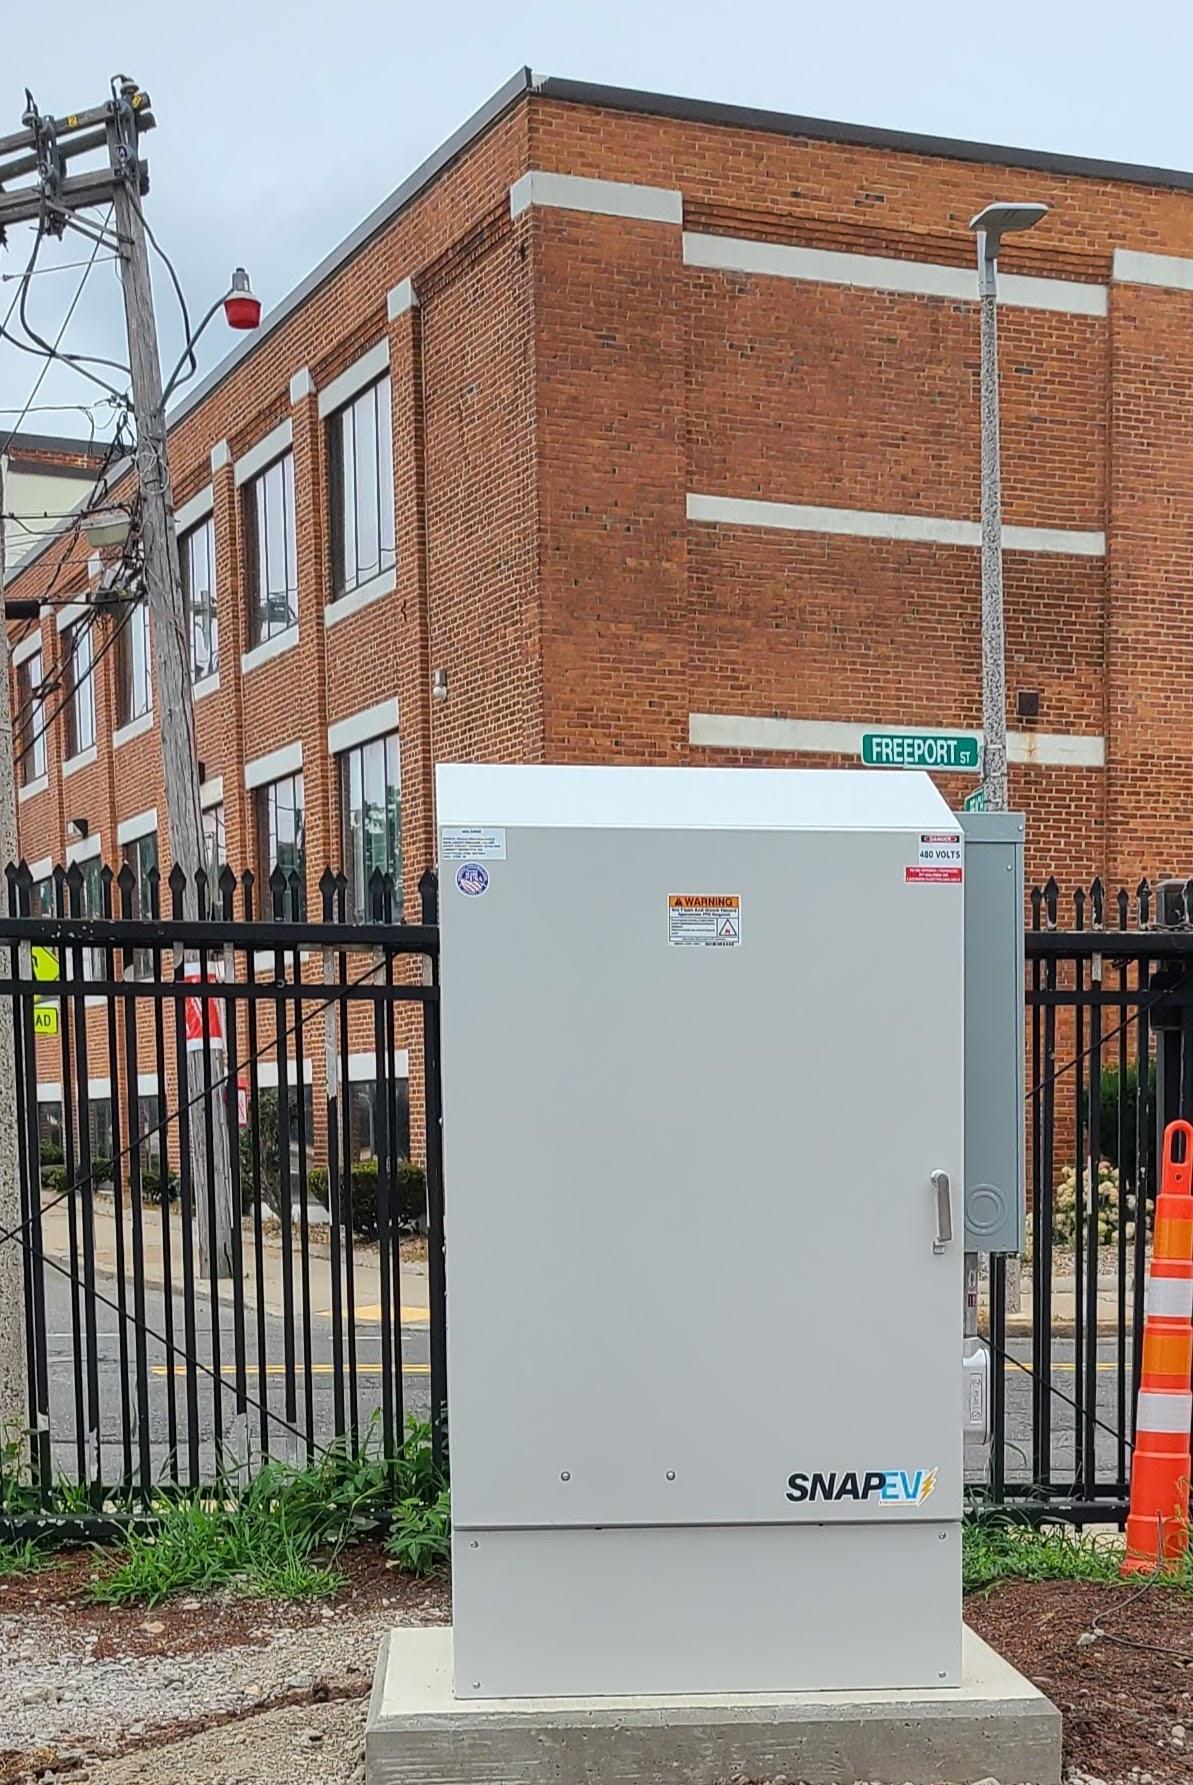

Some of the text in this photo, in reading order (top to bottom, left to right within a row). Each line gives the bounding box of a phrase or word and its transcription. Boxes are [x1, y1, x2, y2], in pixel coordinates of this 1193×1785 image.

[872, 738, 970, 764] FREEPORT ST
[935, 850, 961, 859] VOLTS
[685, 897, 732, 906] WARNING
